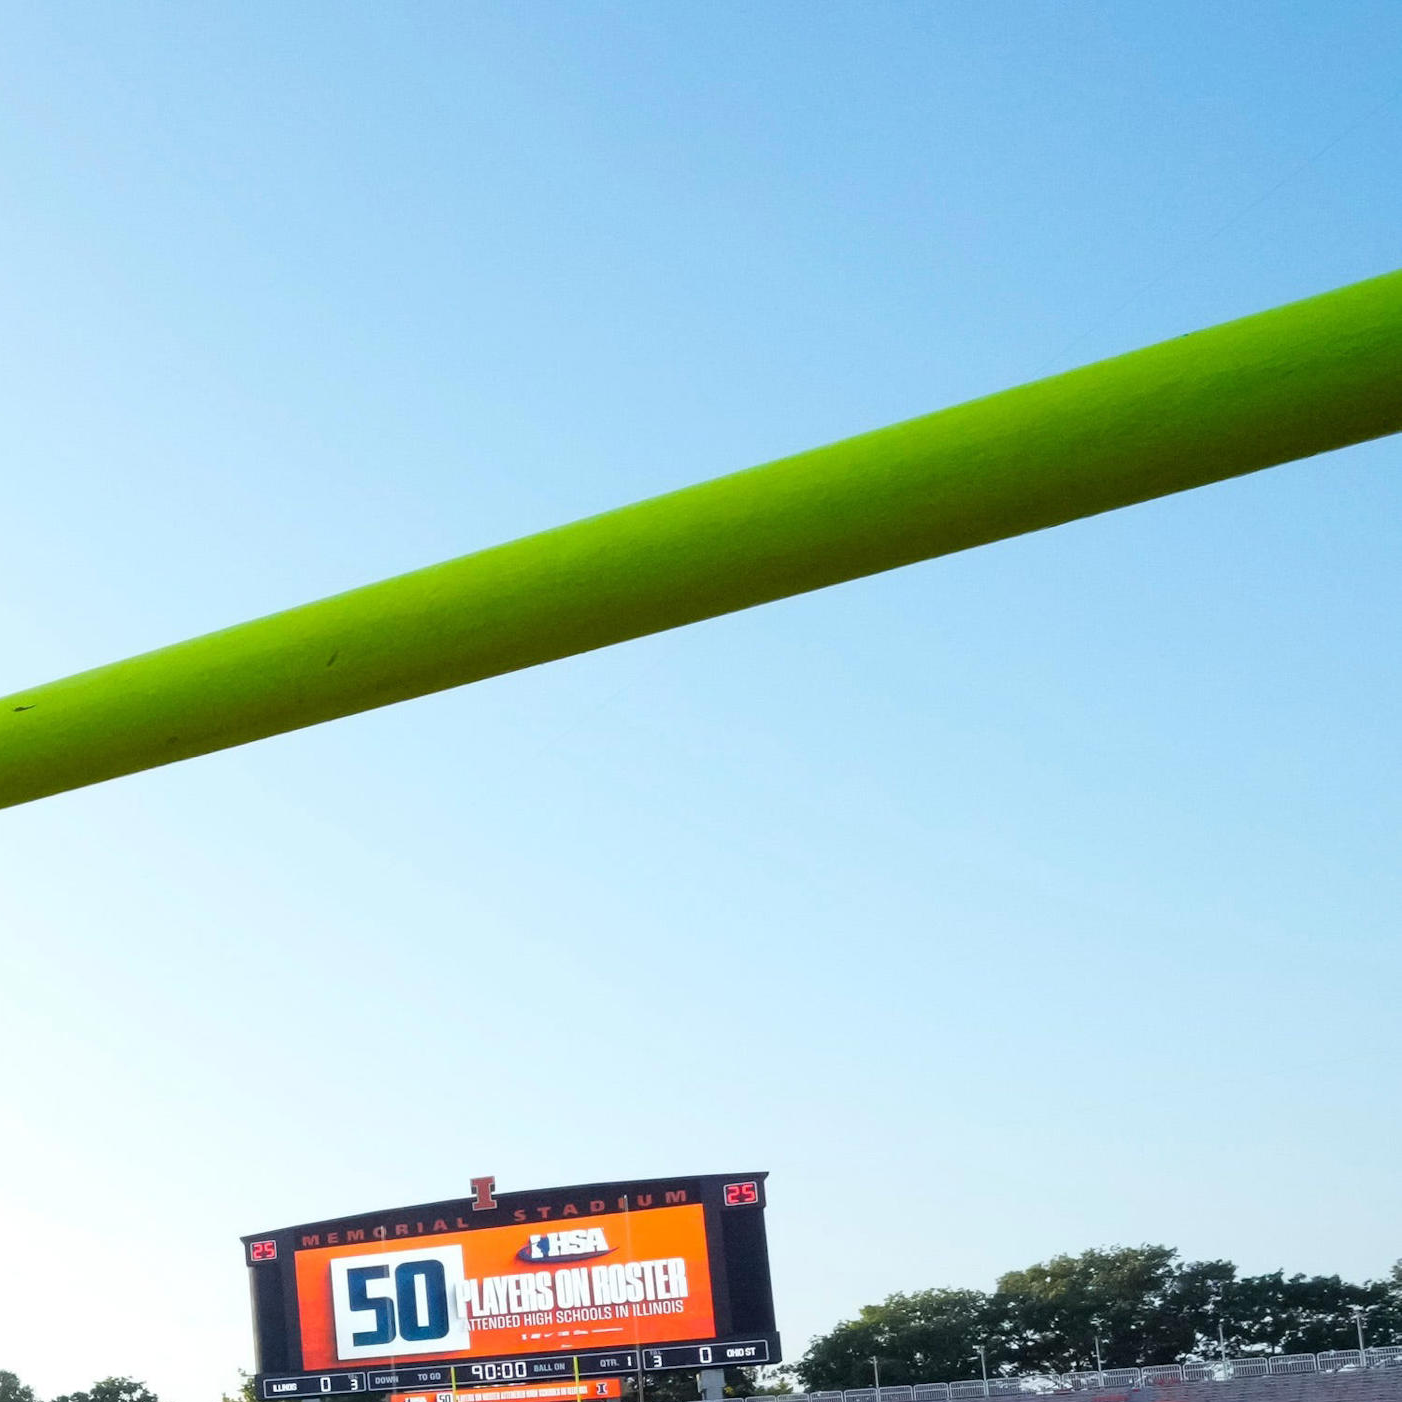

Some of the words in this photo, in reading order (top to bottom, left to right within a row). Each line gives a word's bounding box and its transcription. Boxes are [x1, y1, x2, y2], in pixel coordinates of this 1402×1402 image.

[470, 1176, 497, 1211] I
[726, 1184, 757, 1205] 25
[301, 1216, 470, 1248] MEMORIAL
[512, 1189, 688, 1222] STADIUM
[252, 1241, 276, 1261] 25
[456, 1270, 554, 1317] PLAYERS
[554, 1266, 592, 1310] ON
[591, 1257, 689, 1306] ROSTER
[346, 1259, 450, 1348] 50
[465, 1314, 521, 1332] ATTENDED
[523, 1312, 553, 1327] HIGH
[555, 1306, 613, 1323] SCHOOLS
[615, 1304, 630, 1318] IN
[632, 1300, 685, 1317] ILLINOIS
[626, 1356, 633, 1367] 1
[653, 1356, 663, 1368] 3
[699, 1347, 712, 1364] 0
[744, 1346, 756, 1357] ST
[417, 1373, 428, 1381] TO
[429, 1372, 442, 1380] GO
[470, 1361, 527, 1382] 90:00
[533, 1363, 553, 1373] BALL
[553, 1362, 566, 1371] ON
[319, 1377, 332, 1393] 0
[350, 1379, 359, 1391] 3
[374, 1375, 399, 1385] DOWN
